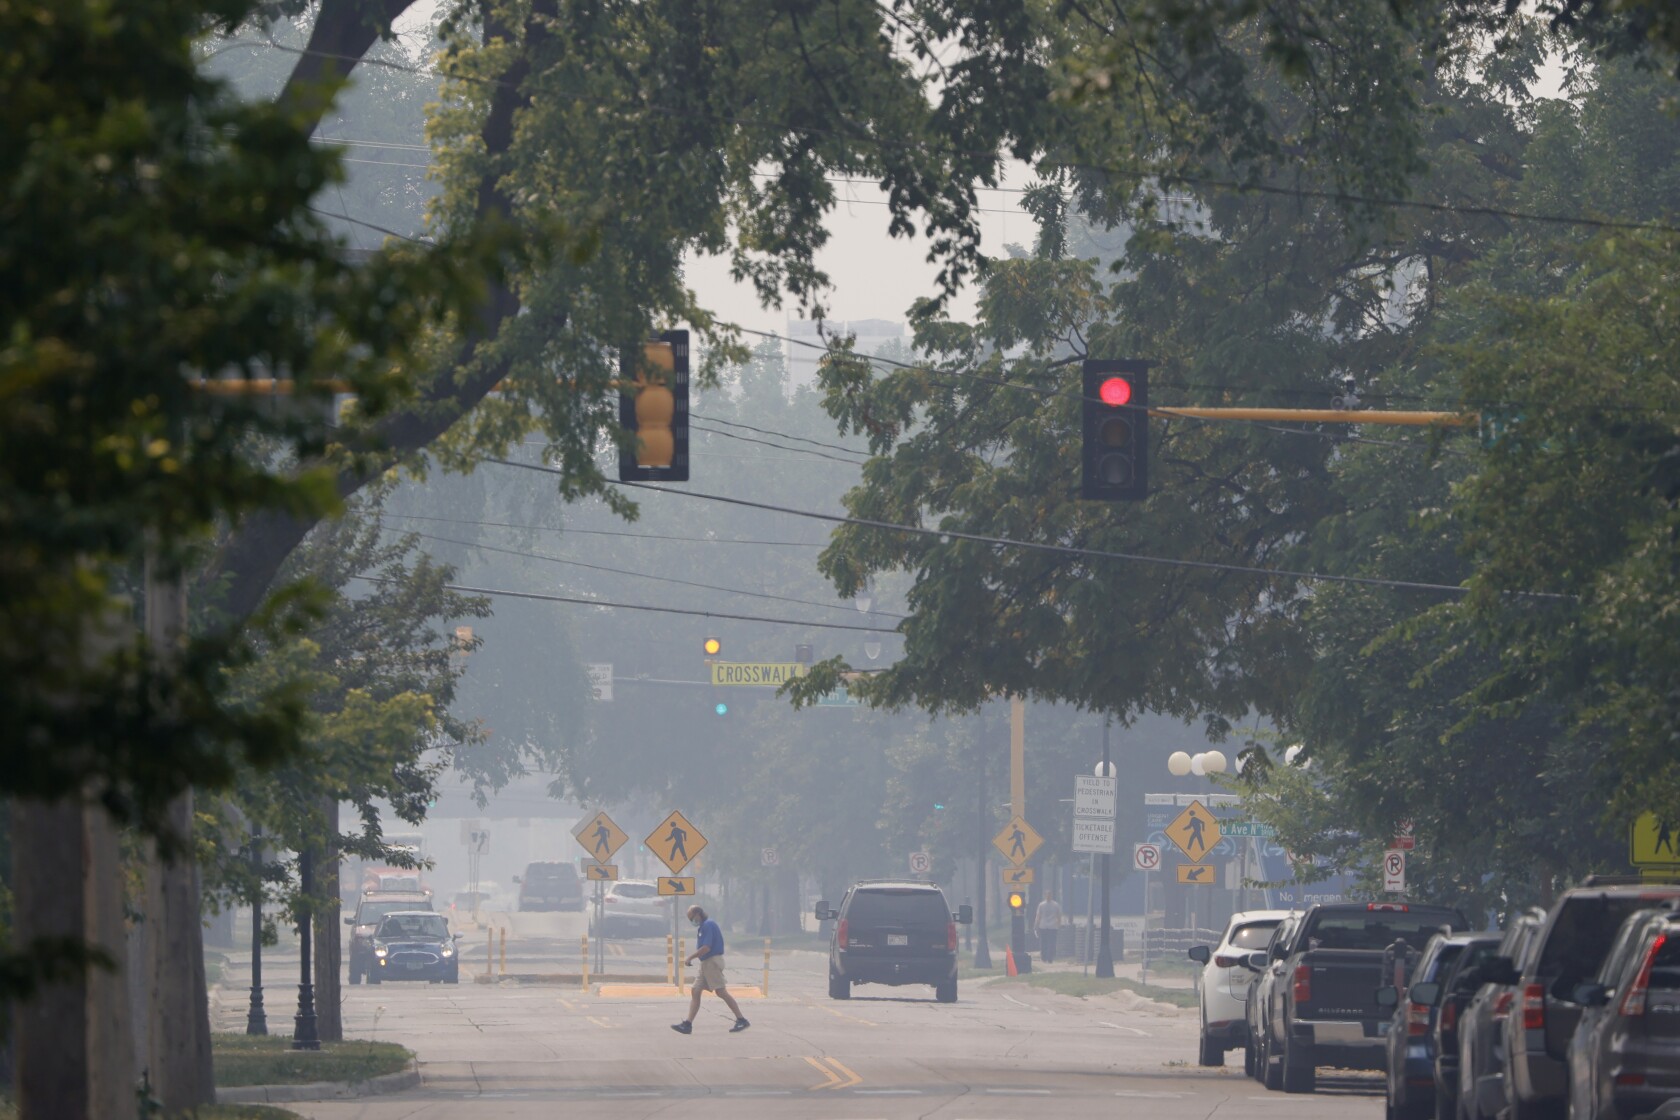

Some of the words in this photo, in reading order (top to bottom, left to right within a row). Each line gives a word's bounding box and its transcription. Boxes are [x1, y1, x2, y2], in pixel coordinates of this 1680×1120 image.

[717, 665, 797, 683] CROSSWALK
[1083, 779, 1100, 787] YIELD
[1077, 789, 1114, 797] PEDESTRIAN
[1076, 807, 1113, 815] CROSSWALK
[1075, 823, 1113, 833] TICKETABLE
[1231, 823, 1248, 835] Ave
[1251, 824, 1256, 835] N
[1079, 833, 1108, 842] OFFENSE
[1279, 892, 1294, 903] No
